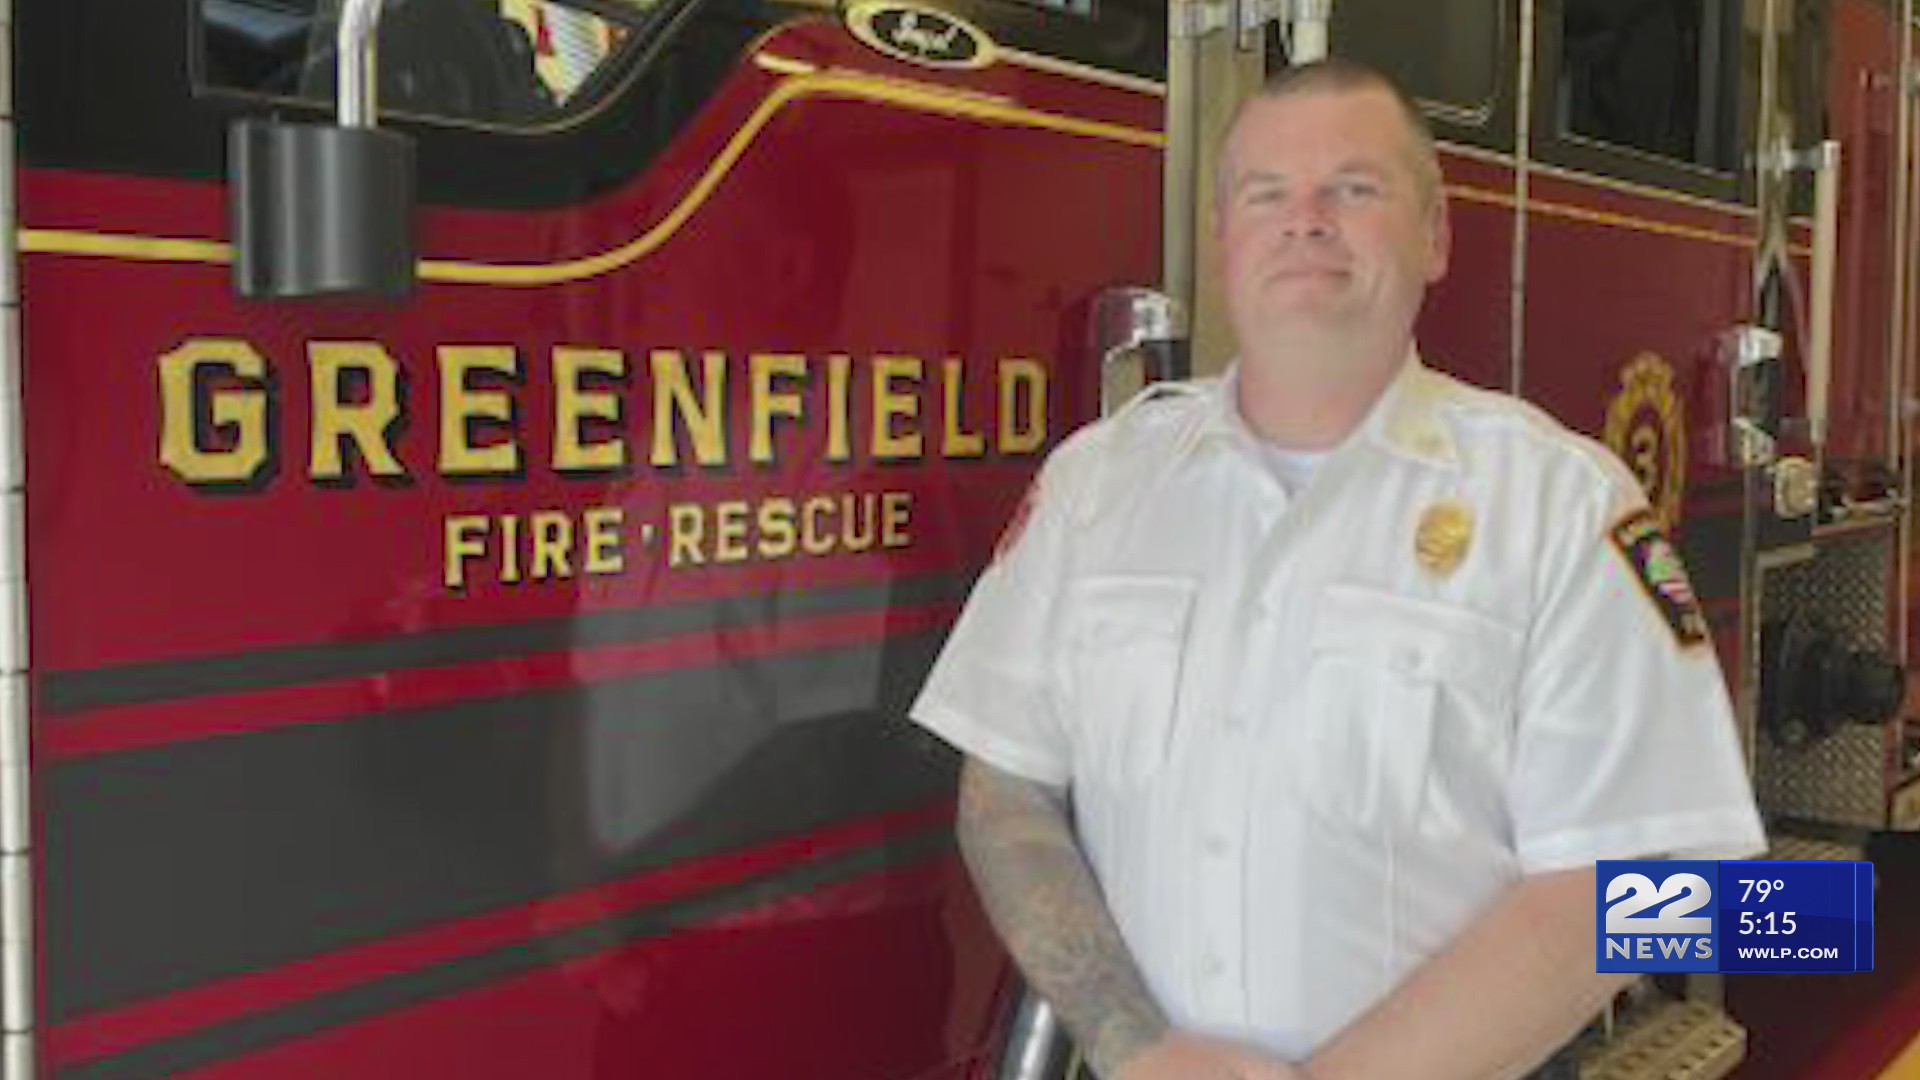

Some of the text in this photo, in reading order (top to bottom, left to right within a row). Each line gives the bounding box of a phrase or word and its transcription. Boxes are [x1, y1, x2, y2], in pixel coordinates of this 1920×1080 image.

[158, 339, 1047, 486] GREENFIELD
[444, 493, 913, 587] FIRE RESCUE
